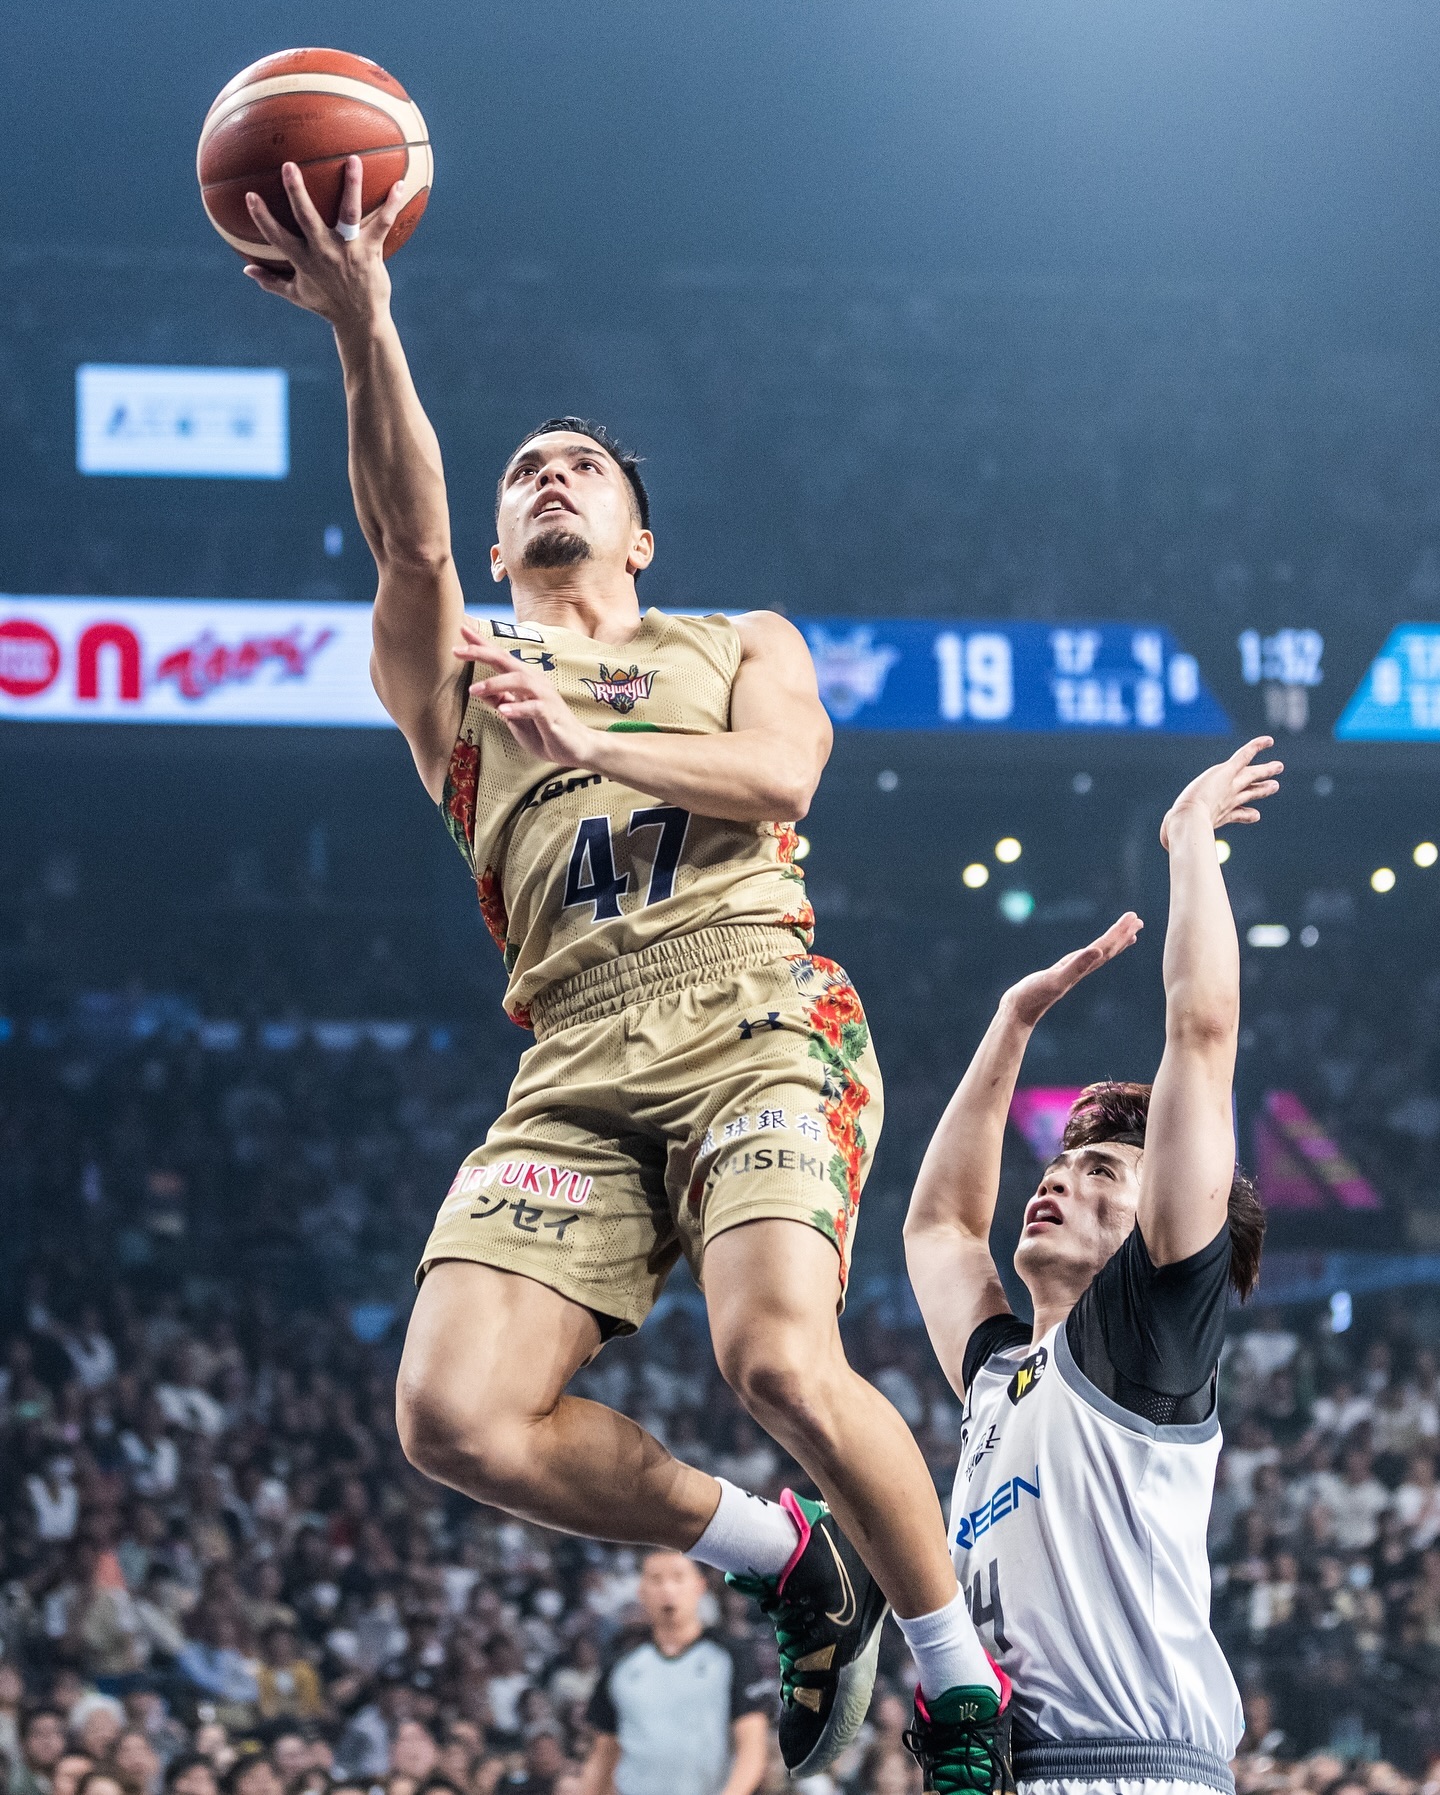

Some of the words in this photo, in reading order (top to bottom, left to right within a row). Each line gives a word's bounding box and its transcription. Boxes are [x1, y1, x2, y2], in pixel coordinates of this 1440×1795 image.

[937, 632, 1012, 721] 19
[563, 806, 692, 924] 47
[956, 1465, 1041, 1550] REEN
[964, 1558, 1013, 1654] 4
